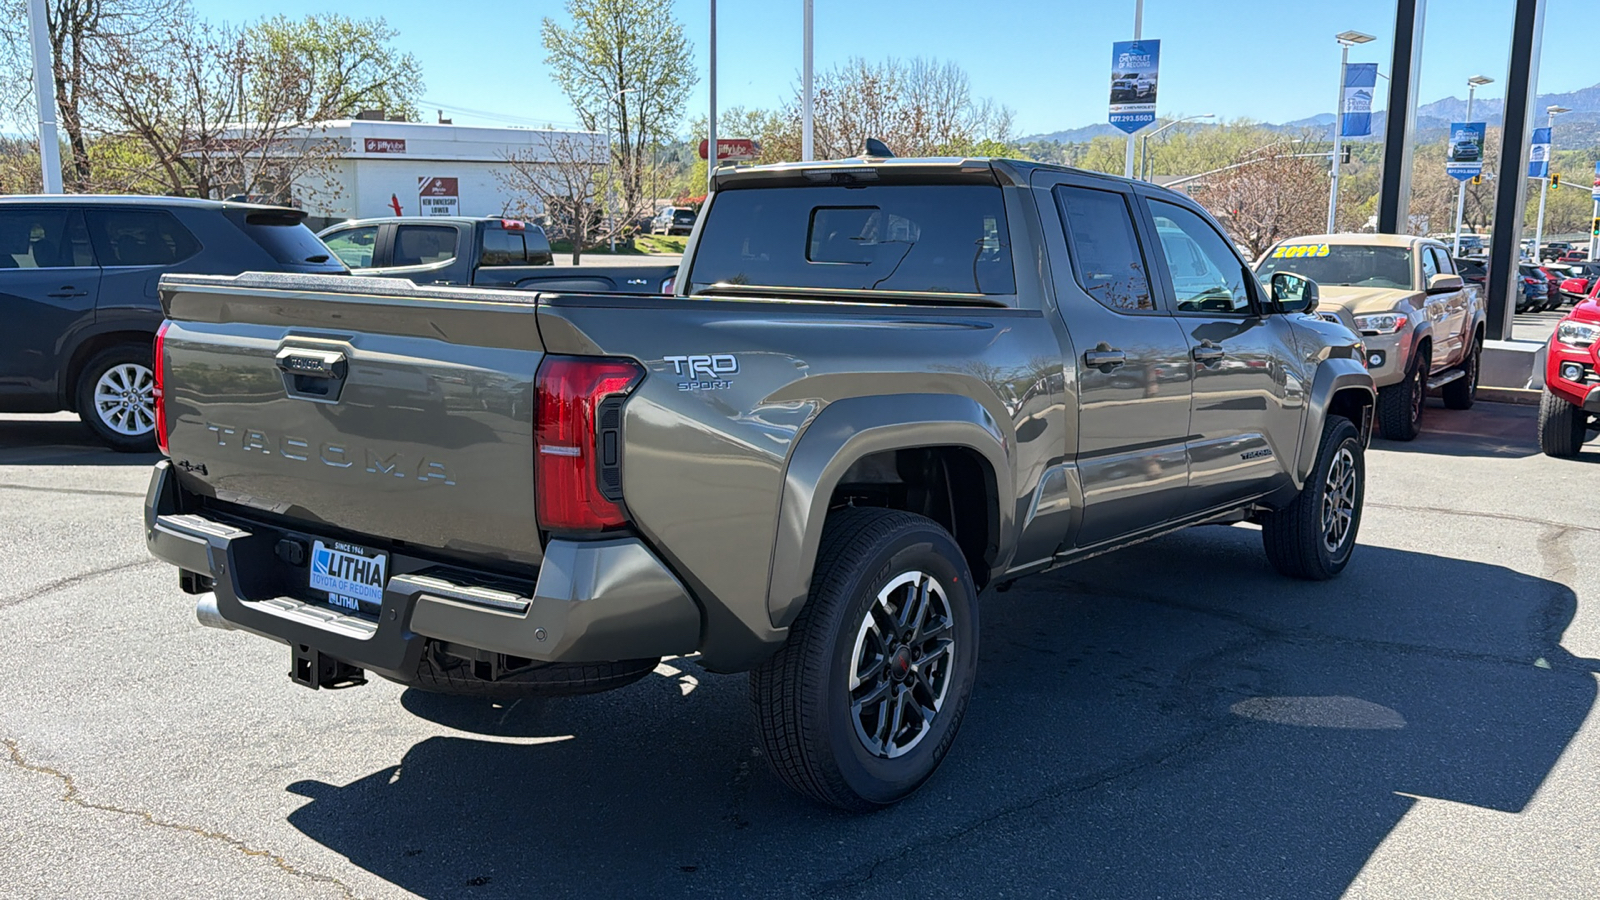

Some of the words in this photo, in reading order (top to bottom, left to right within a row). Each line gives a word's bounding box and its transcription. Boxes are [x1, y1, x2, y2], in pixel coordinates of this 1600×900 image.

[1119, 54, 1151, 62] CHEVROLET
[1110, 114, 1153, 122] 877.293.5503
[291, 358, 324, 371] TOYOTA
[663, 354, 738, 379] TRD
[677, 380, 734, 392] SPORT
[206, 422, 457, 486] TACOMA
[335, 542, 350, 552] SINCE
[352, 545, 363, 554] 1946
[328, 553, 382, 587] LITHIA
[312, 573, 337, 588] TOYOTA
[338, 580, 349, 591] OF
[349, 583, 382, 599] REDDING
[337, 594, 359, 610] LITHIA
